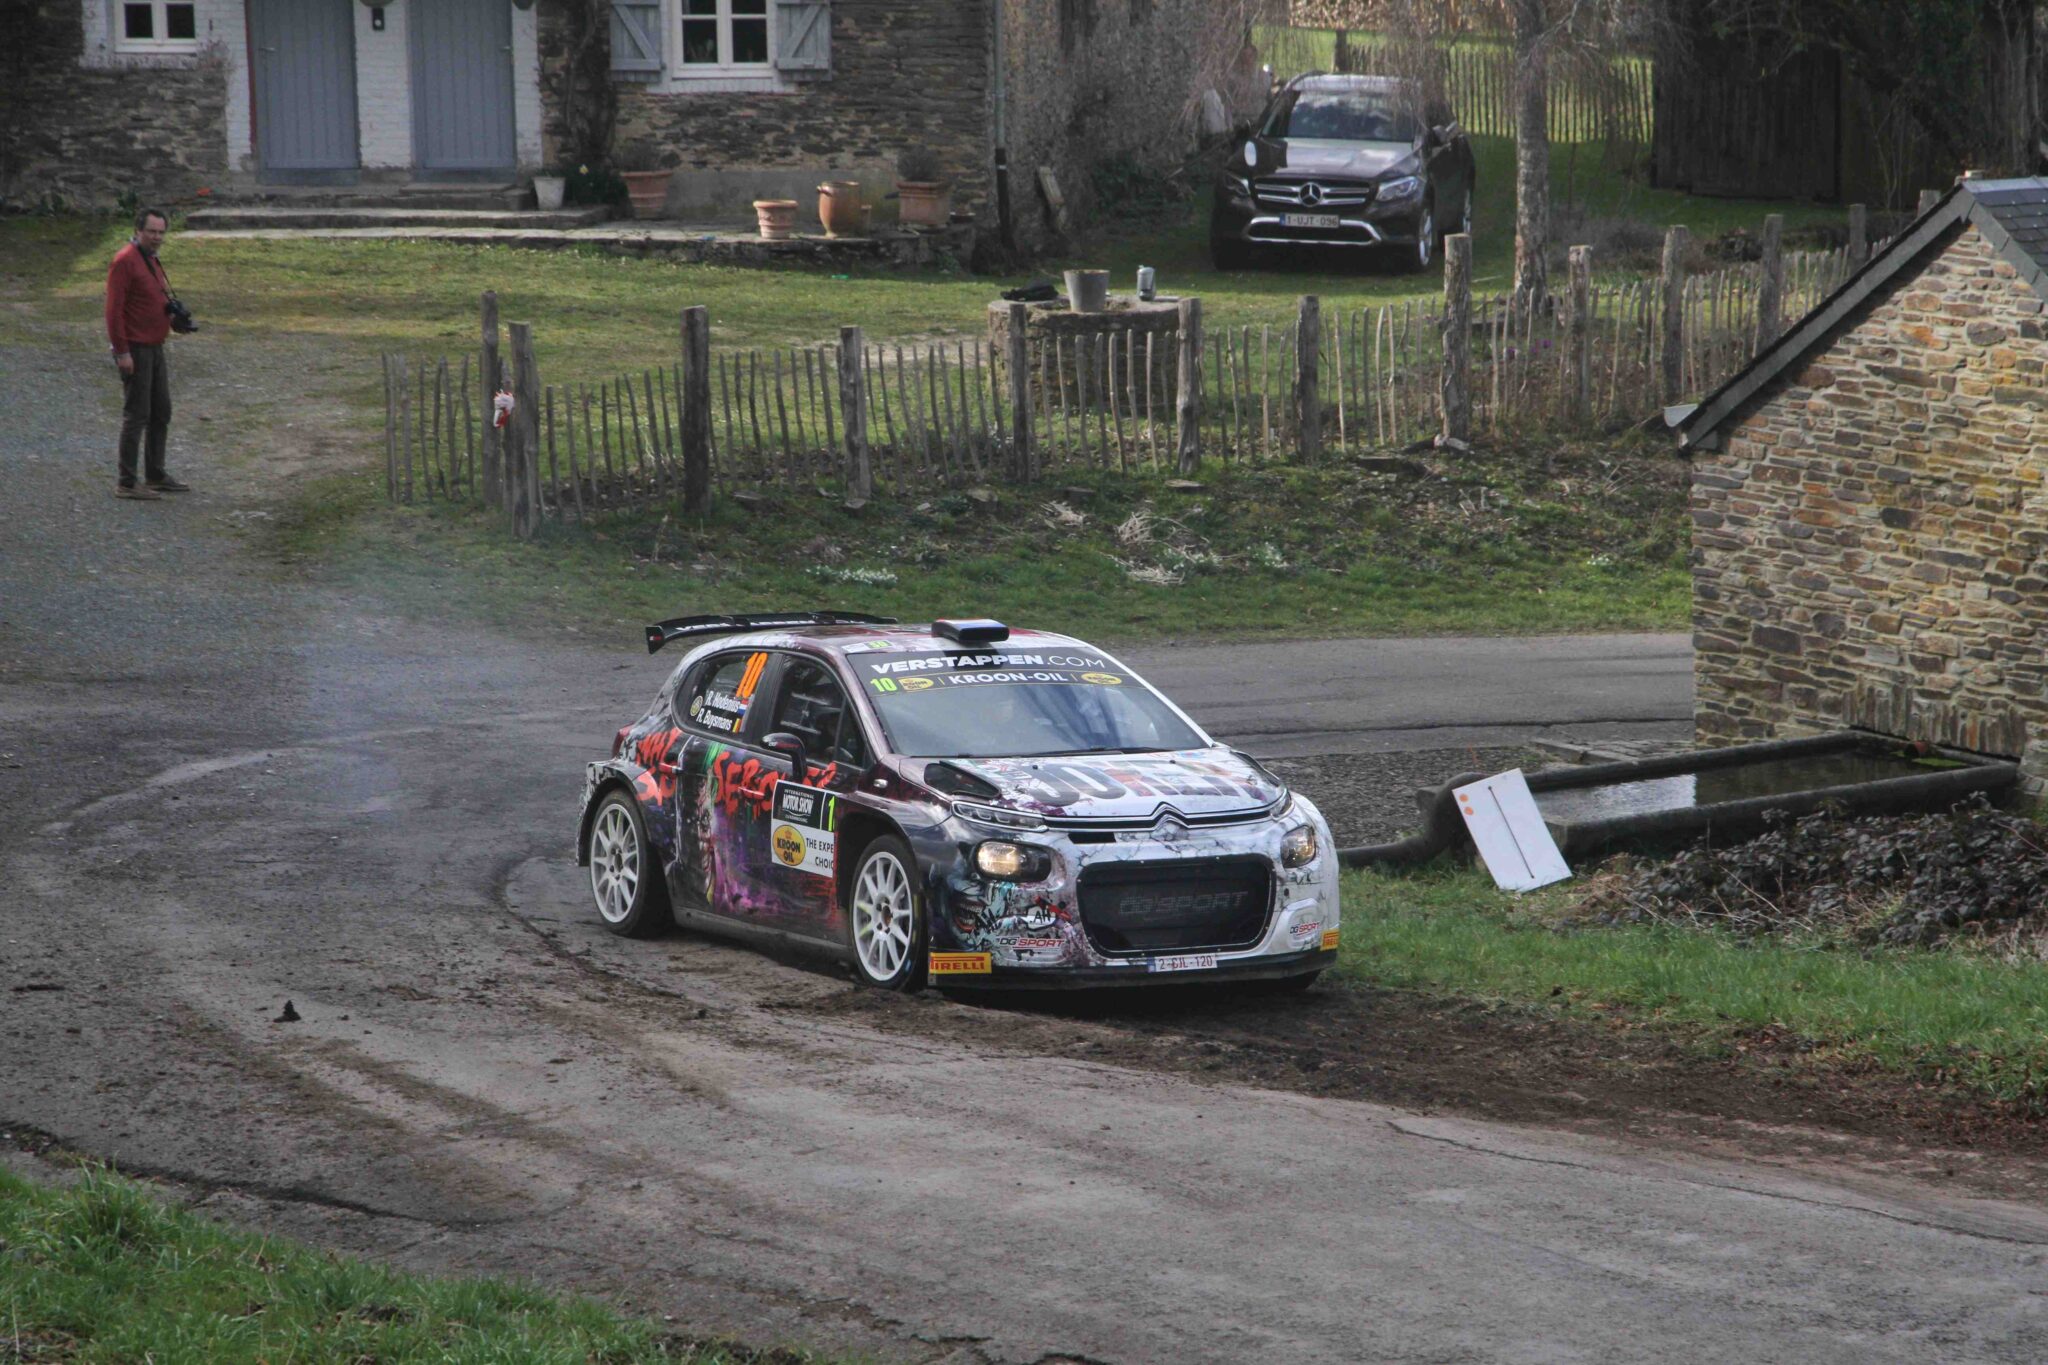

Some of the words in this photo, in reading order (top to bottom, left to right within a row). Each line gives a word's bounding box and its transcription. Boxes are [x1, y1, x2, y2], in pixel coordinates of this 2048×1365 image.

[870, 654, 1105, 674] VERSTAPPEN.COM
[736, 652, 768, 698] 10
[948, 672, 1068, 685] KROON-OIL
[870, 677, 898, 692] 10
[782, 793, 799, 811] MOTOR
[798, 797, 814, 815] SHOW
[777, 837, 801, 853] KROON
[806, 837, 818, 849] THE
[783, 850, 795, 863] OIL
[1018, 939, 1064, 947] SPORT
[930, 956, 985, 970] PIRELLI
